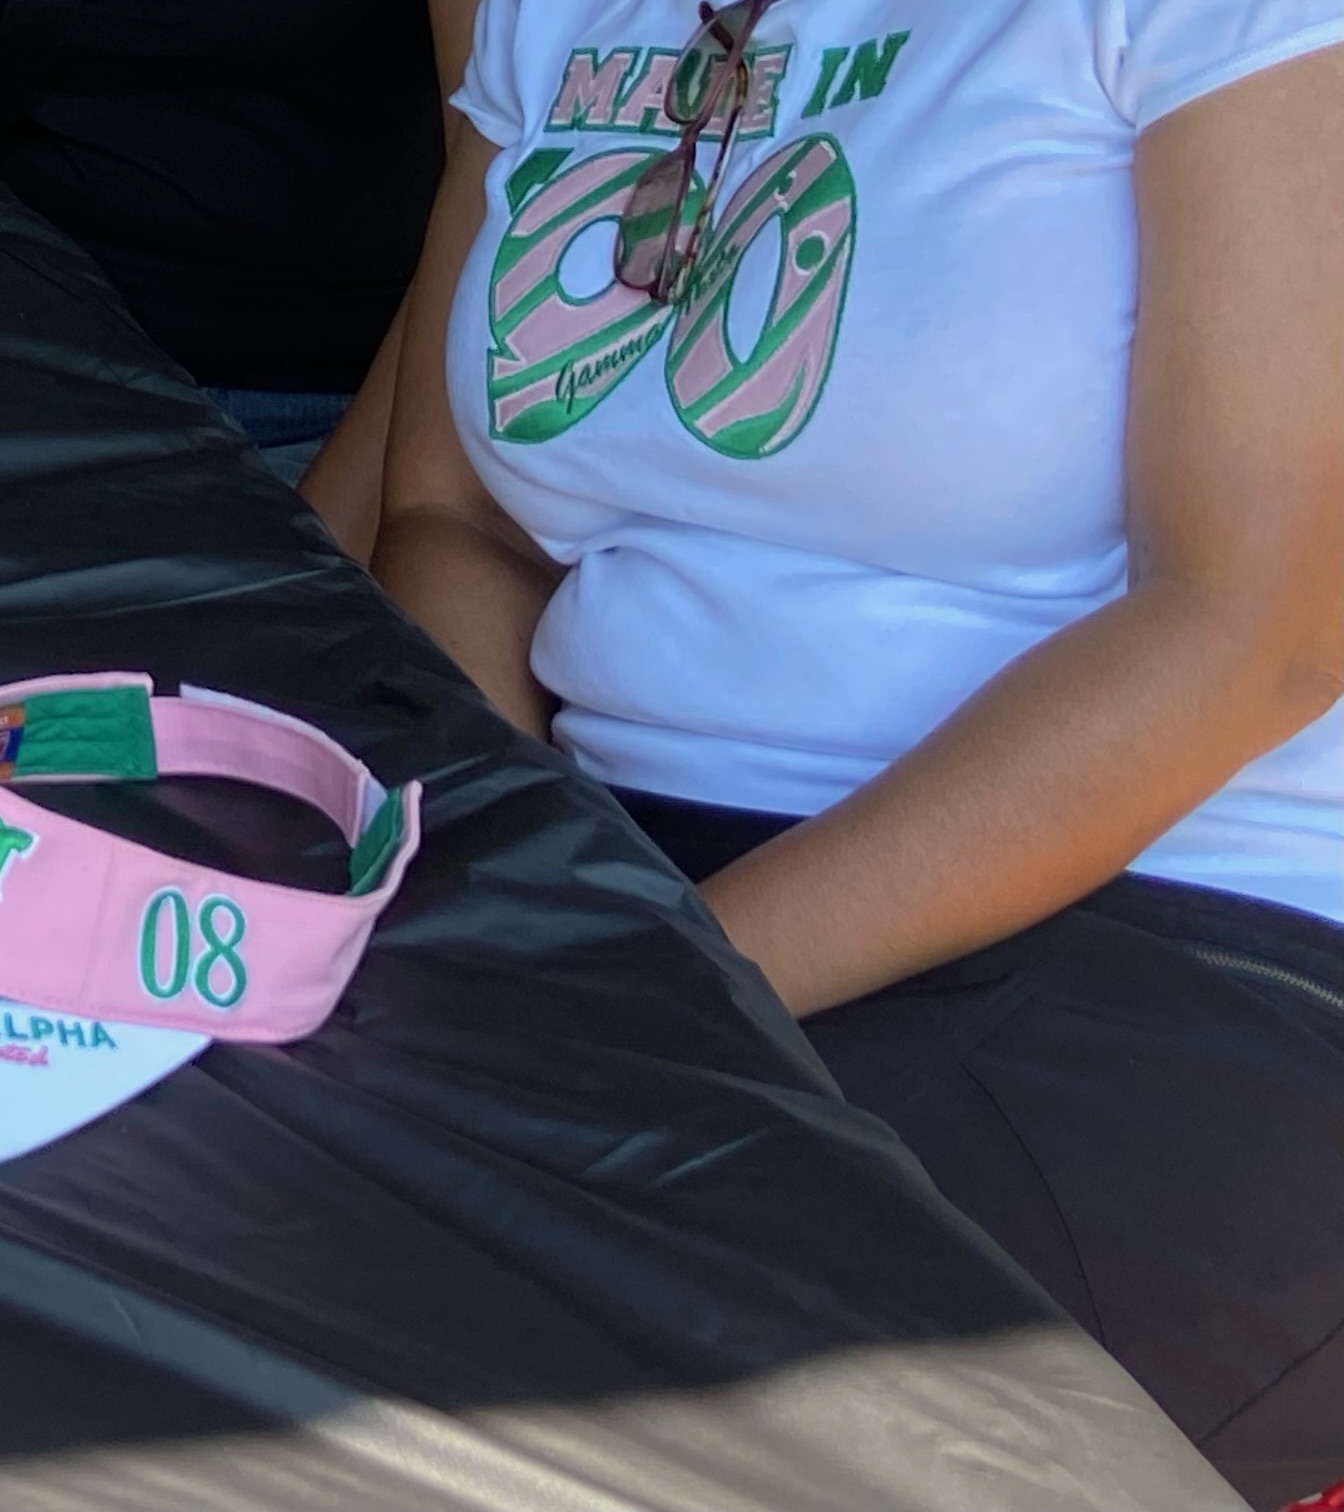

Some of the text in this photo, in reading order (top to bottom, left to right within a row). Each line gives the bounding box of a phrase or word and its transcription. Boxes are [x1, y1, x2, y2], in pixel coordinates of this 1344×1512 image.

[543, 30, 911, 143] MADE IN
[138, 886, 248, 1008] 08
